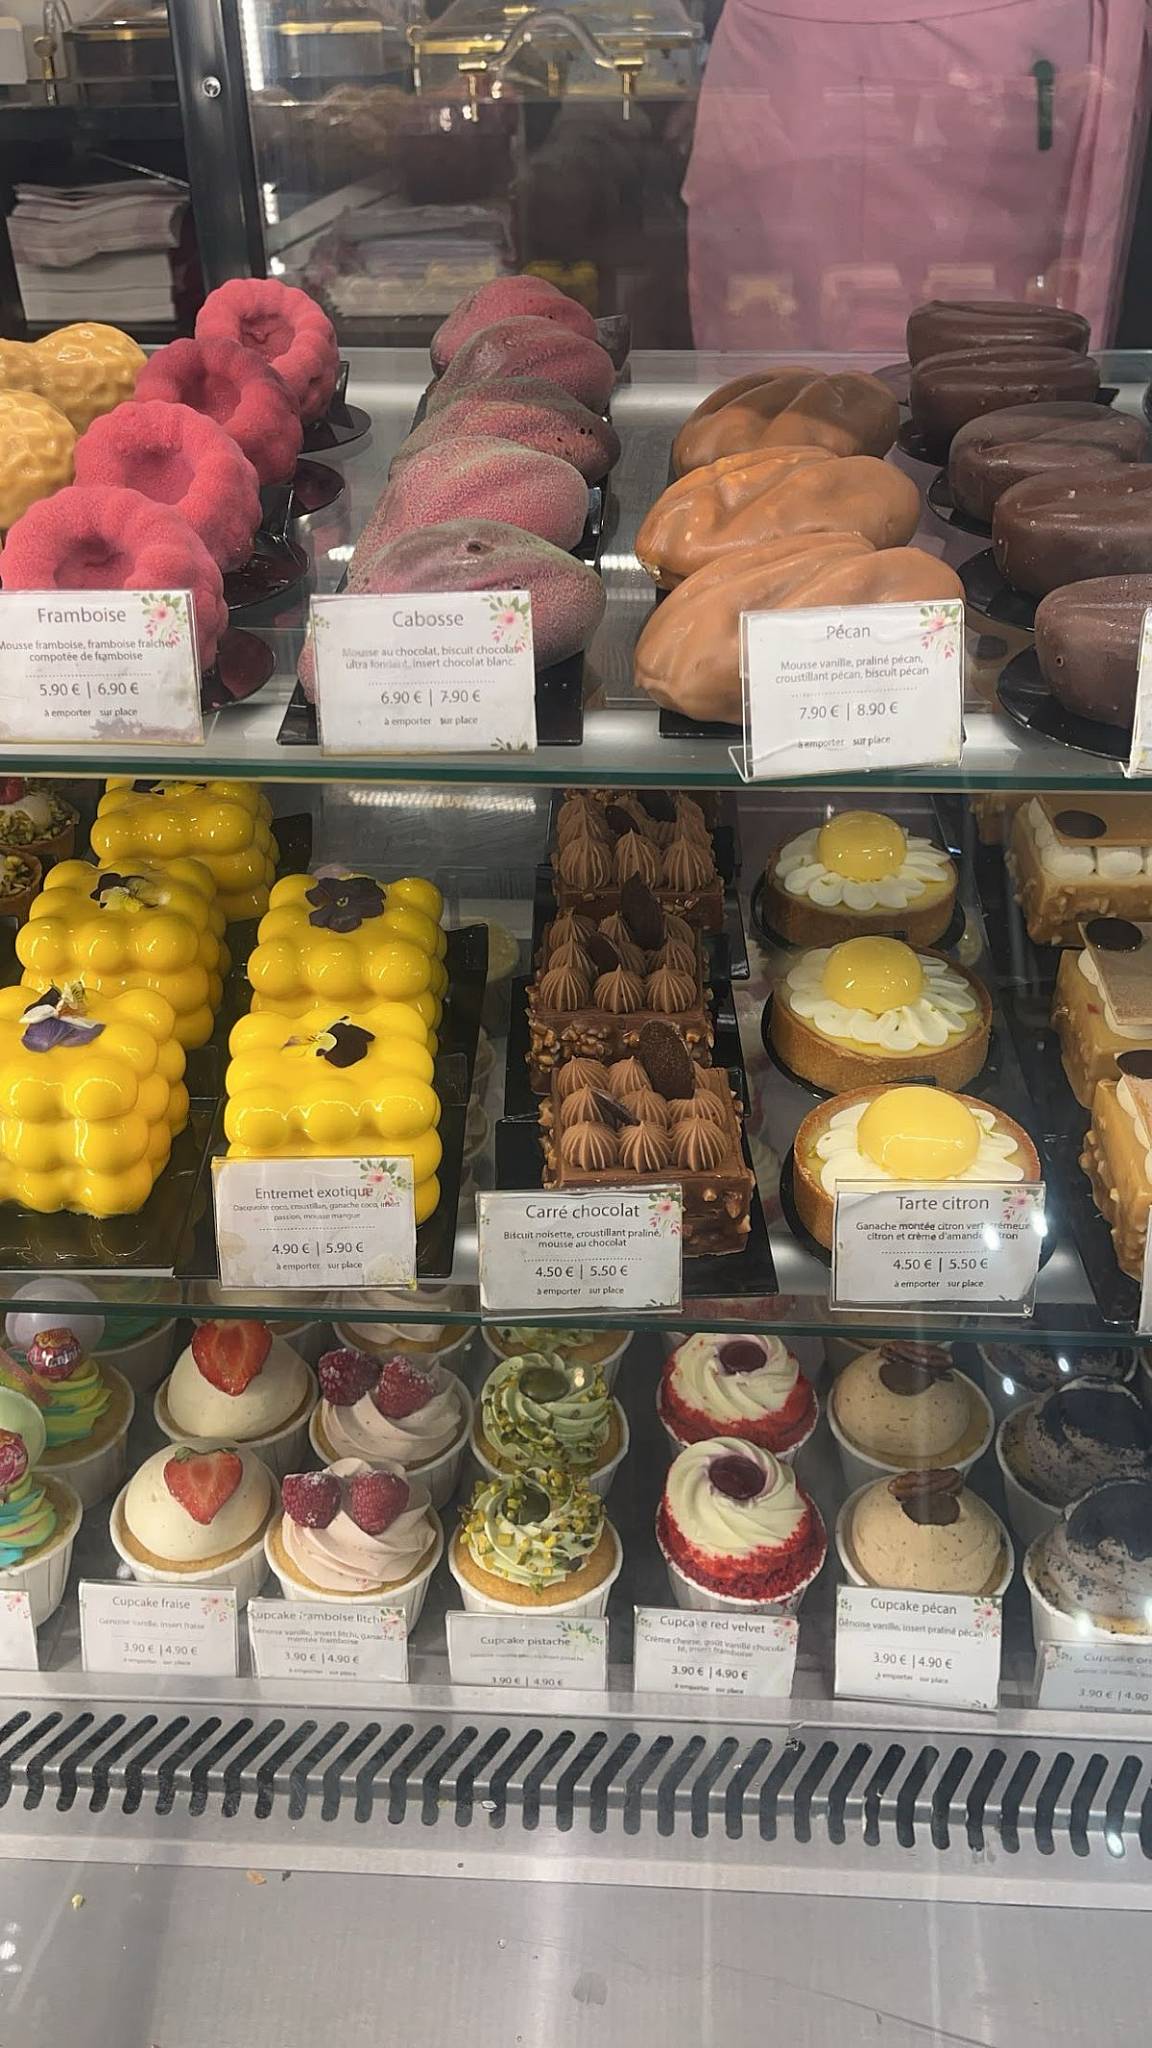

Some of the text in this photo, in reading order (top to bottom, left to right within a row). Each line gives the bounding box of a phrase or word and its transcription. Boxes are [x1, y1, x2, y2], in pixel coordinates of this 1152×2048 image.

[37, 607, 127, 623] Framboise
[392, 610, 464, 628] Cabosse
[826, 624, 871, 640] Pécan
[35, 641, 85, 650] framboise,
[88, 640, 136, 649] framboise
[381, 649, 393, 657] au
[395, 647, 439, 657] chocolat,
[442, 646, 473, 655] biscuit
[80, 652, 93, 660] de
[781, 661, 817, 670] Mousse
[856, 656, 889, 668] praliné
[892, 654, 923, 667] pécan,
[346, 660, 368, 669] ultra
[413, 659, 440, 668] insert
[443, 658, 484, 668] chocolat
[776, 667, 929, 684] croustillant pécan, biscuit pécan
[40, 682, 139, 696] 5.90 € 6.90 €
[381, 690, 480, 705] 6.90 € 7.90 €
[52, 709, 91, 718] emporter
[115, 708, 138, 718] place
[800, 702, 898, 720] 7.90 € 8.90 €
[392, 718, 431, 727] emporter
[455, 716, 478, 727] place
[853, 738, 866, 746] sur
[868, 736, 891, 747] place
[256, 1186, 373, 1200] Entremet exotique
[329, 1201, 359, 1210] ganache
[897, 1196, 989, 1210] Tarte citron
[526, 1202, 640, 1219] Carré chocolat
[856, 1222, 896, 1230] Ganache
[504, 1228, 661, 1239] Biscuit noisette, croustillant praliné,
[867, 1232, 894, 1240] citron
[907, 1232, 936, 1240] crème
[272, 1242, 363, 1255] 4.90 € 5.90 €
[589, 1239, 626, 1247] chocolat
[283, 1263, 319, 1271] emporter
[341, 1261, 362, 1270] place
[893, 1258, 988, 1270] 4.50 € 5.50 €
[536, 1265, 628, 1278] 4.50 € 5.50 €
[544, 1287, 581, 1296] emporter
[603, 1286, 624, 1295] place
[901, 1280, 940, 1289] emporter
[962, 1280, 984, 1288] place
[112, 1596, 190, 1609] Cupcake fraise
[871, 1598, 957, 1615] Cupcake pécan
[711, 1621, 728, 1630] red
[732, 1623, 765, 1634] velvet
[481, 1637, 571, 1646] Cupcake pistache
[124, 1642, 197, 1655] 3.90 € 4.90 €
[310, 1653, 316, 1662] €
[327, 1654, 350, 1663] 4.90
[353, 1655, 359, 1663] €
[874, 1653, 952, 1669] 3.90 € 4.90 €
[672, 1666, 749, 1680] 3.90 € 4.90 €
